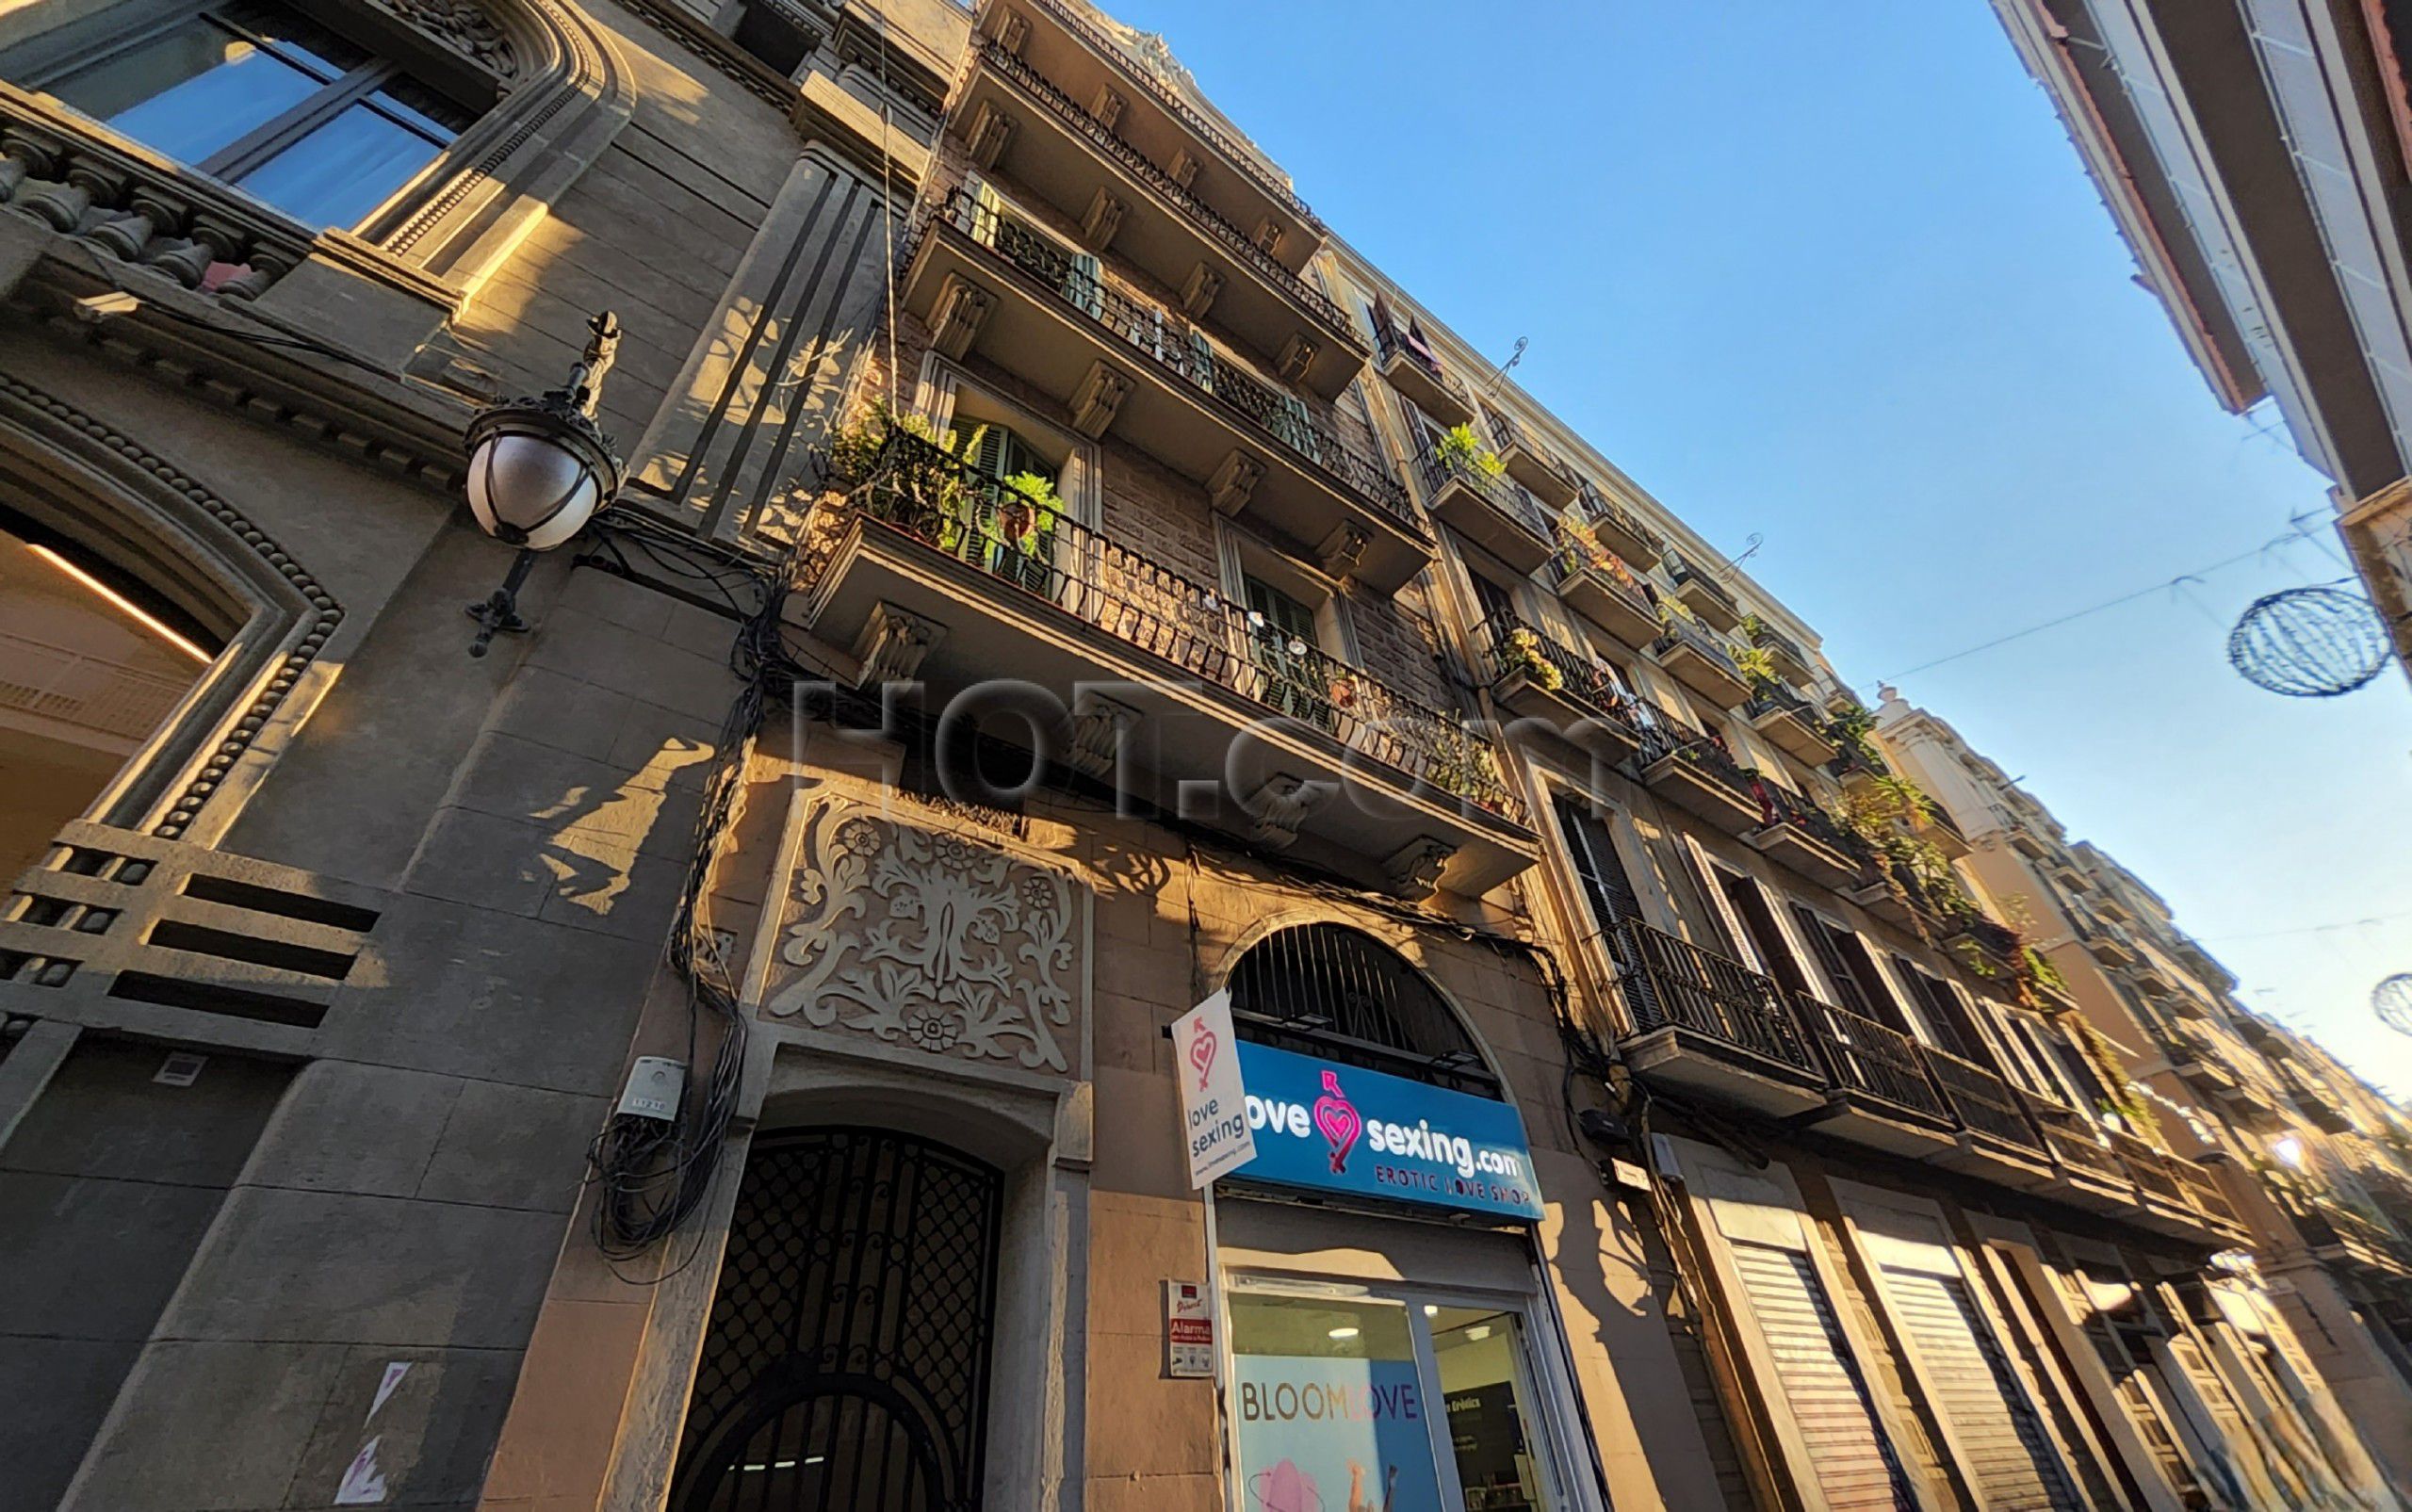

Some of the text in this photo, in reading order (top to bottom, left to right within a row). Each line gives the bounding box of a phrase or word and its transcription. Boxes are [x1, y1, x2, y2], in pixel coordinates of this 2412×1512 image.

[1187, 1098, 1219, 1130] love
[1192, 1114, 1245, 1158] sexing
[1245, 1095, 1522, 1179] ove sexing.com
[1375, 1165, 1530, 1205] EROTIC LOVE SHOP
[1170, 1320, 1212, 1335] Alarma
